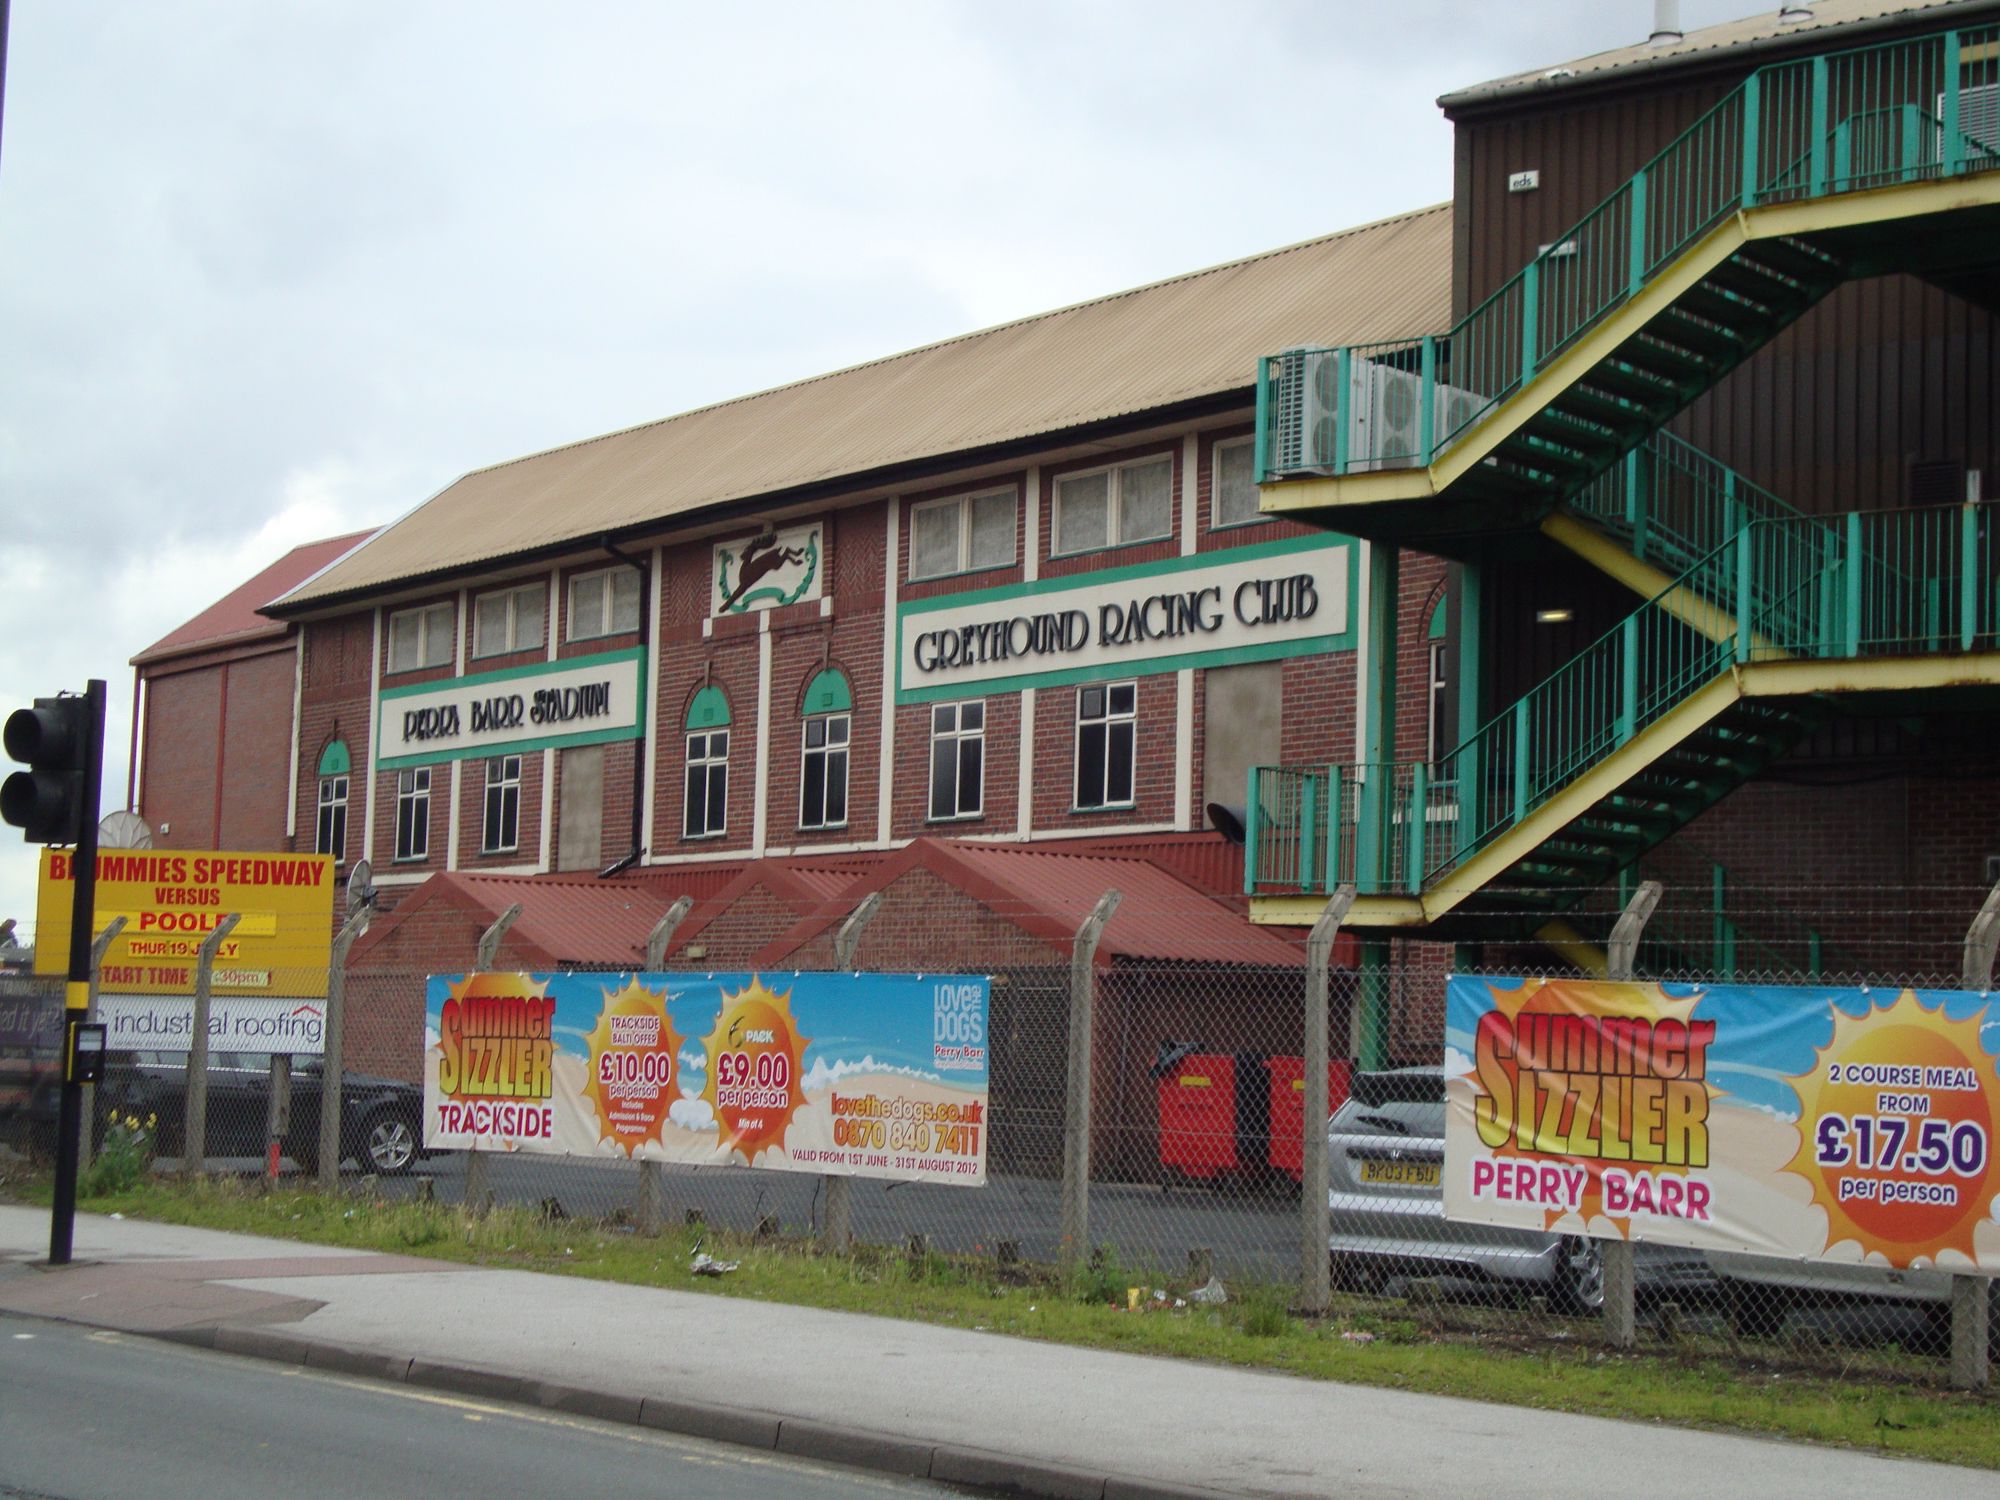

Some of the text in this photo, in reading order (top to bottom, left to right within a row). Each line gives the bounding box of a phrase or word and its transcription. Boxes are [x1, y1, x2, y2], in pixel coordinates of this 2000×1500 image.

[914, 573, 1318, 672] GREYHOUND RACING CLUB
[403, 682, 610, 742] PERRY BARR STADIUM
[193, 859, 325, 886] SPEEDWAY
[155, 888, 220, 905] VERSUS
[130, 942, 238, 956] THUR 19 JLY
[99, 966, 145, 983] TART
[150, 967, 188, 984] TIME
[114, 1009, 322, 1043] industal roofing
[611, 1017, 659, 1030] TRACKSIDE
[746, 1030, 774, 1043] PACK
[934, 1011, 982, 1043] DOGS
[612, 1033, 657, 1045] BALTI OFFER
[935, 1044, 984, 1060] Perry Barr
[440, 1036, 552, 1098] SIZZLER
[601, 1054, 670, 1083] £10.00
[719, 1053, 788, 1088] £9.00
[1829, 1065, 1977, 1088] 2 COURSE MEAL
[610, 1086, 658, 1099] per person
[719, 1090, 787, 1108] per person
[1878, 1095, 1929, 1112] FROM
[438, 1105, 552, 1138] TRACKSIDE
[831, 1093, 984, 1125] lovethedogs.co.uk
[1475, 1068, 1709, 1168] SIZZLER
[834, 1118, 979, 1156] 0870 840 7411
[1817, 1117, 1983, 1173] £17.50
[792, 1149, 816, 1162] VALID
[819, 1151, 845, 1164] FROM
[848, 1153, 863, 1165] 1ST
[865, 1155, 888, 1167] JUNE
[895, 1156, 915, 1169] 31ST
[918, 1159, 954, 1172] AUGUST
[957, 1161, 978, 1175] 2012
[1473, 1161, 1710, 1220] PERRY BARR
[1841, 1179, 1955, 1203] per person
